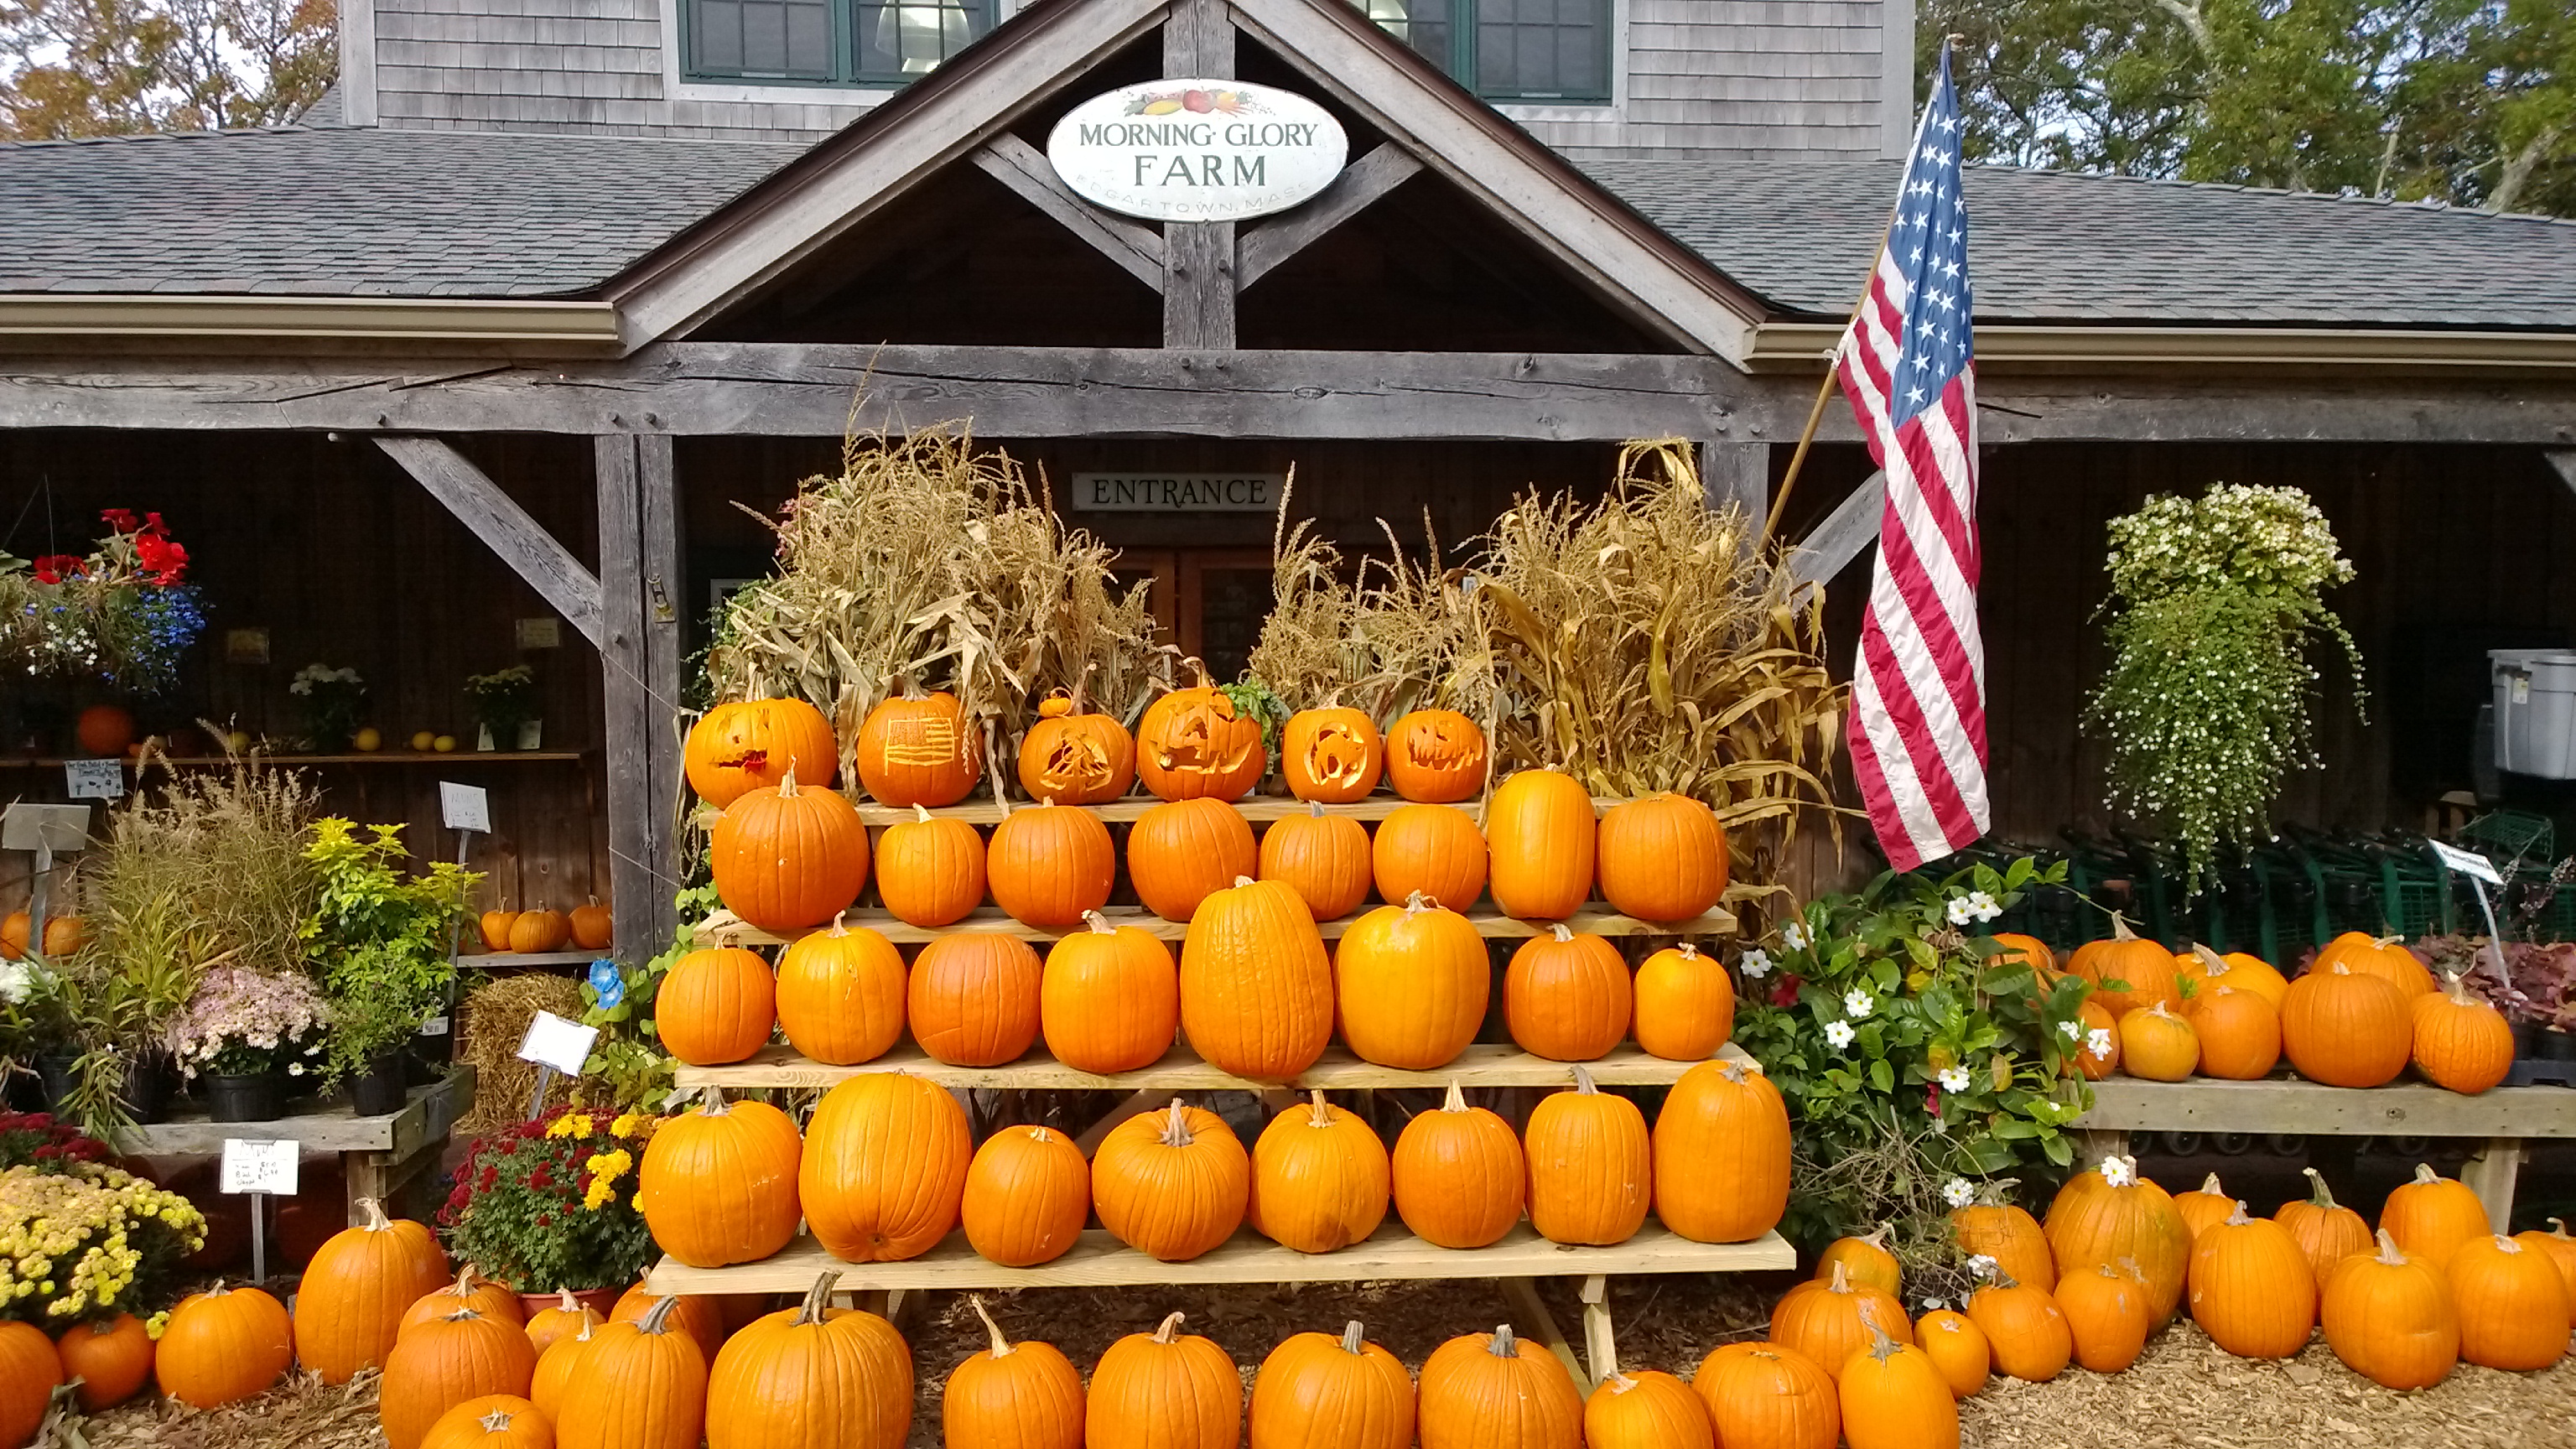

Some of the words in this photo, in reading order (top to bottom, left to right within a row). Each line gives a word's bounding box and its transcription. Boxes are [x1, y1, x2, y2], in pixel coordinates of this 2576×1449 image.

[1079, 122, 1212, 147] MORNING
[1224, 122, 1319, 147] GLORY
[1134, 154, 1266, 187] FARM
[1092, 480, 1268, 509] ENTRANCE
